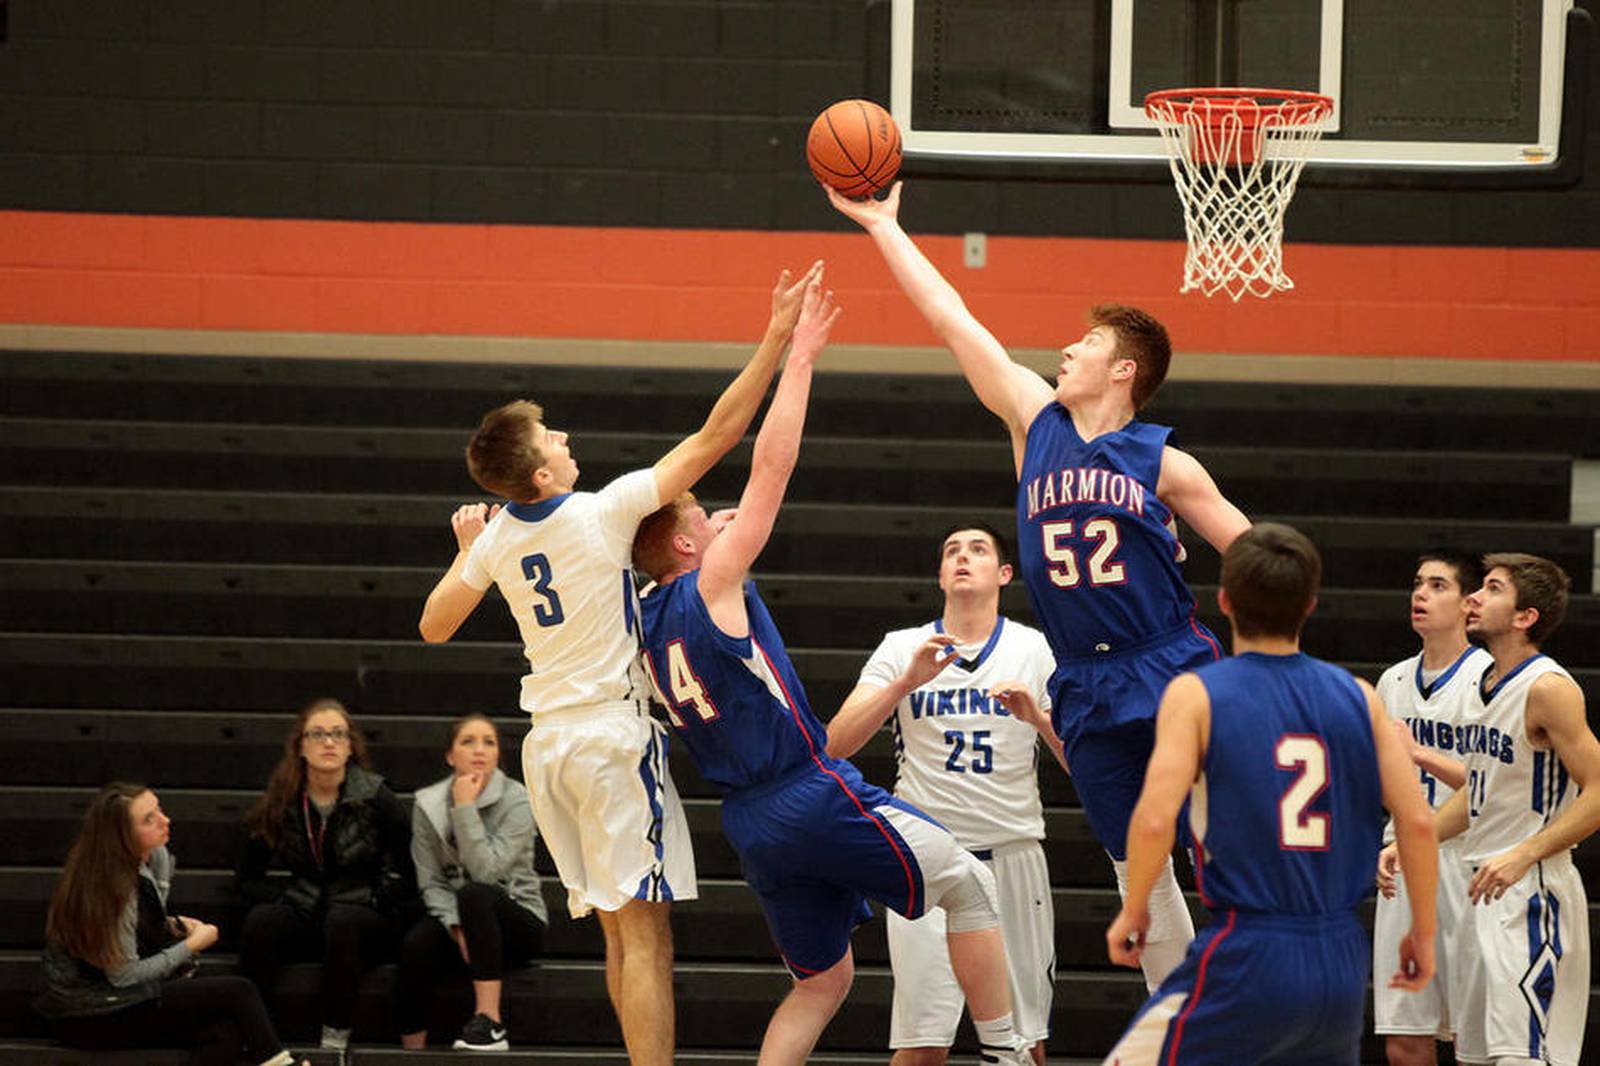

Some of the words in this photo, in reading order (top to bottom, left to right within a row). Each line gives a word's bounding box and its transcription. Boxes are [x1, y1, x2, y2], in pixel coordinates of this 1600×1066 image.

[1026, 468, 1145, 520] MARMION
[1041, 515, 1129, 588] 52
[520, 552, 565, 628] 3
[944, 730, 993, 774] 25
[1274, 732, 1331, 851] 2
